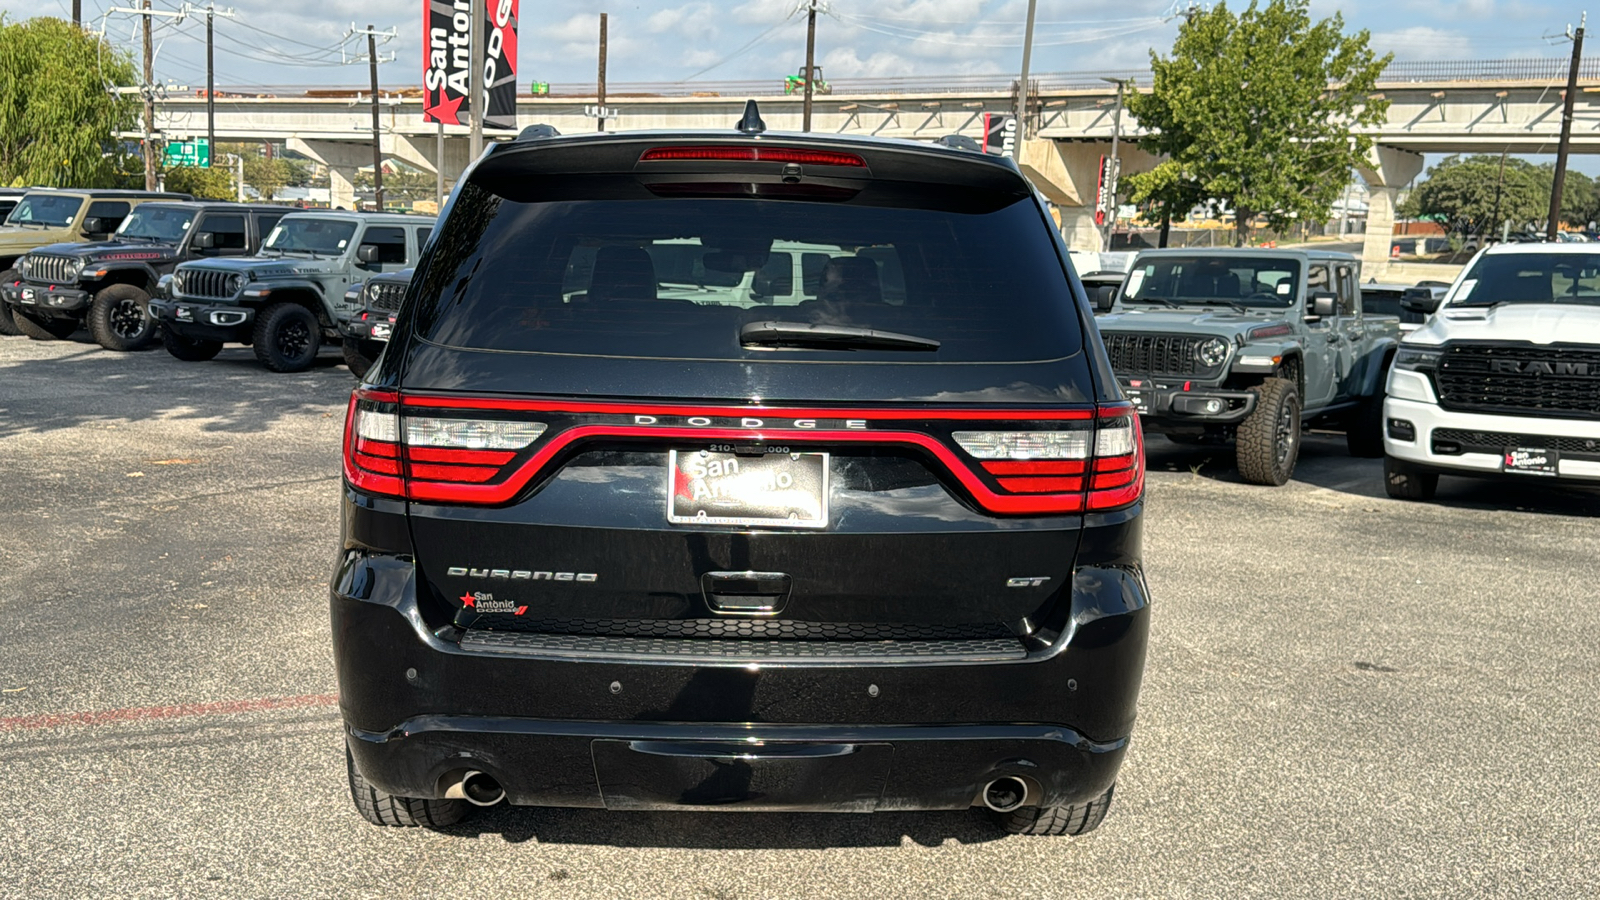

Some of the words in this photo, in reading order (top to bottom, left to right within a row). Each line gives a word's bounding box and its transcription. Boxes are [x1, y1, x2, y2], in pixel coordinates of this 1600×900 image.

[425, 27, 448, 91] San
[1491, 359, 1588, 376] RAM
[634, 414, 867, 430] DODGE
[1511, 451, 1529, 459] San
[1511, 456, 1547, 466] Antonio
[689, 457, 739, 478] San
[447, 566, 599, 582] DURANGO
[1006, 576, 1051, 587] GT
[474, 591, 493, 601] San
[475, 600, 515, 609] Antonio
